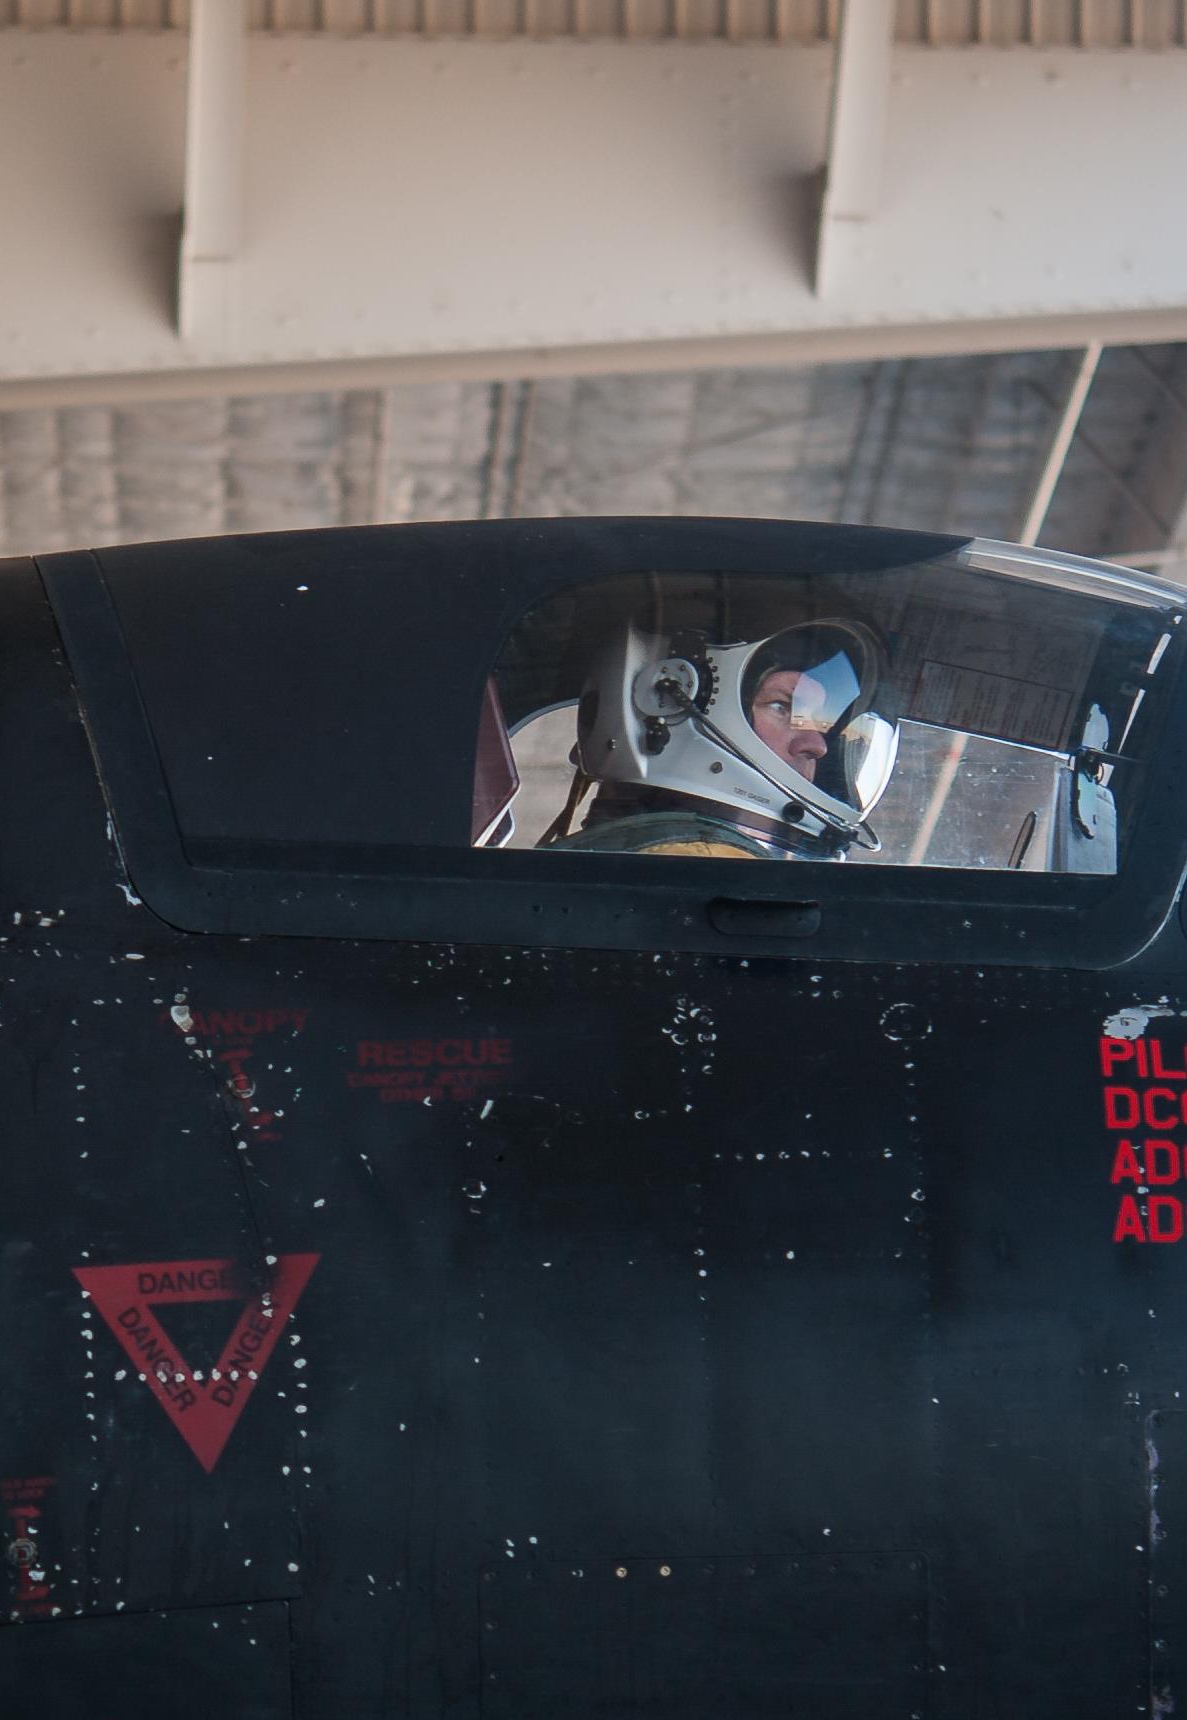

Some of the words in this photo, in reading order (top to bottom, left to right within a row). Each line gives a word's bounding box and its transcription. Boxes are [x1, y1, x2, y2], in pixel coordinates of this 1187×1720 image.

[357, 1038, 513, 1067] RESCUE
[1100, 1038, 1187, 1078] PIL
[1103, 1086, 1187, 1129] DC
[1110, 1139, 1187, 1185] AD
[117, 1306, 197, 1412] DANGER
